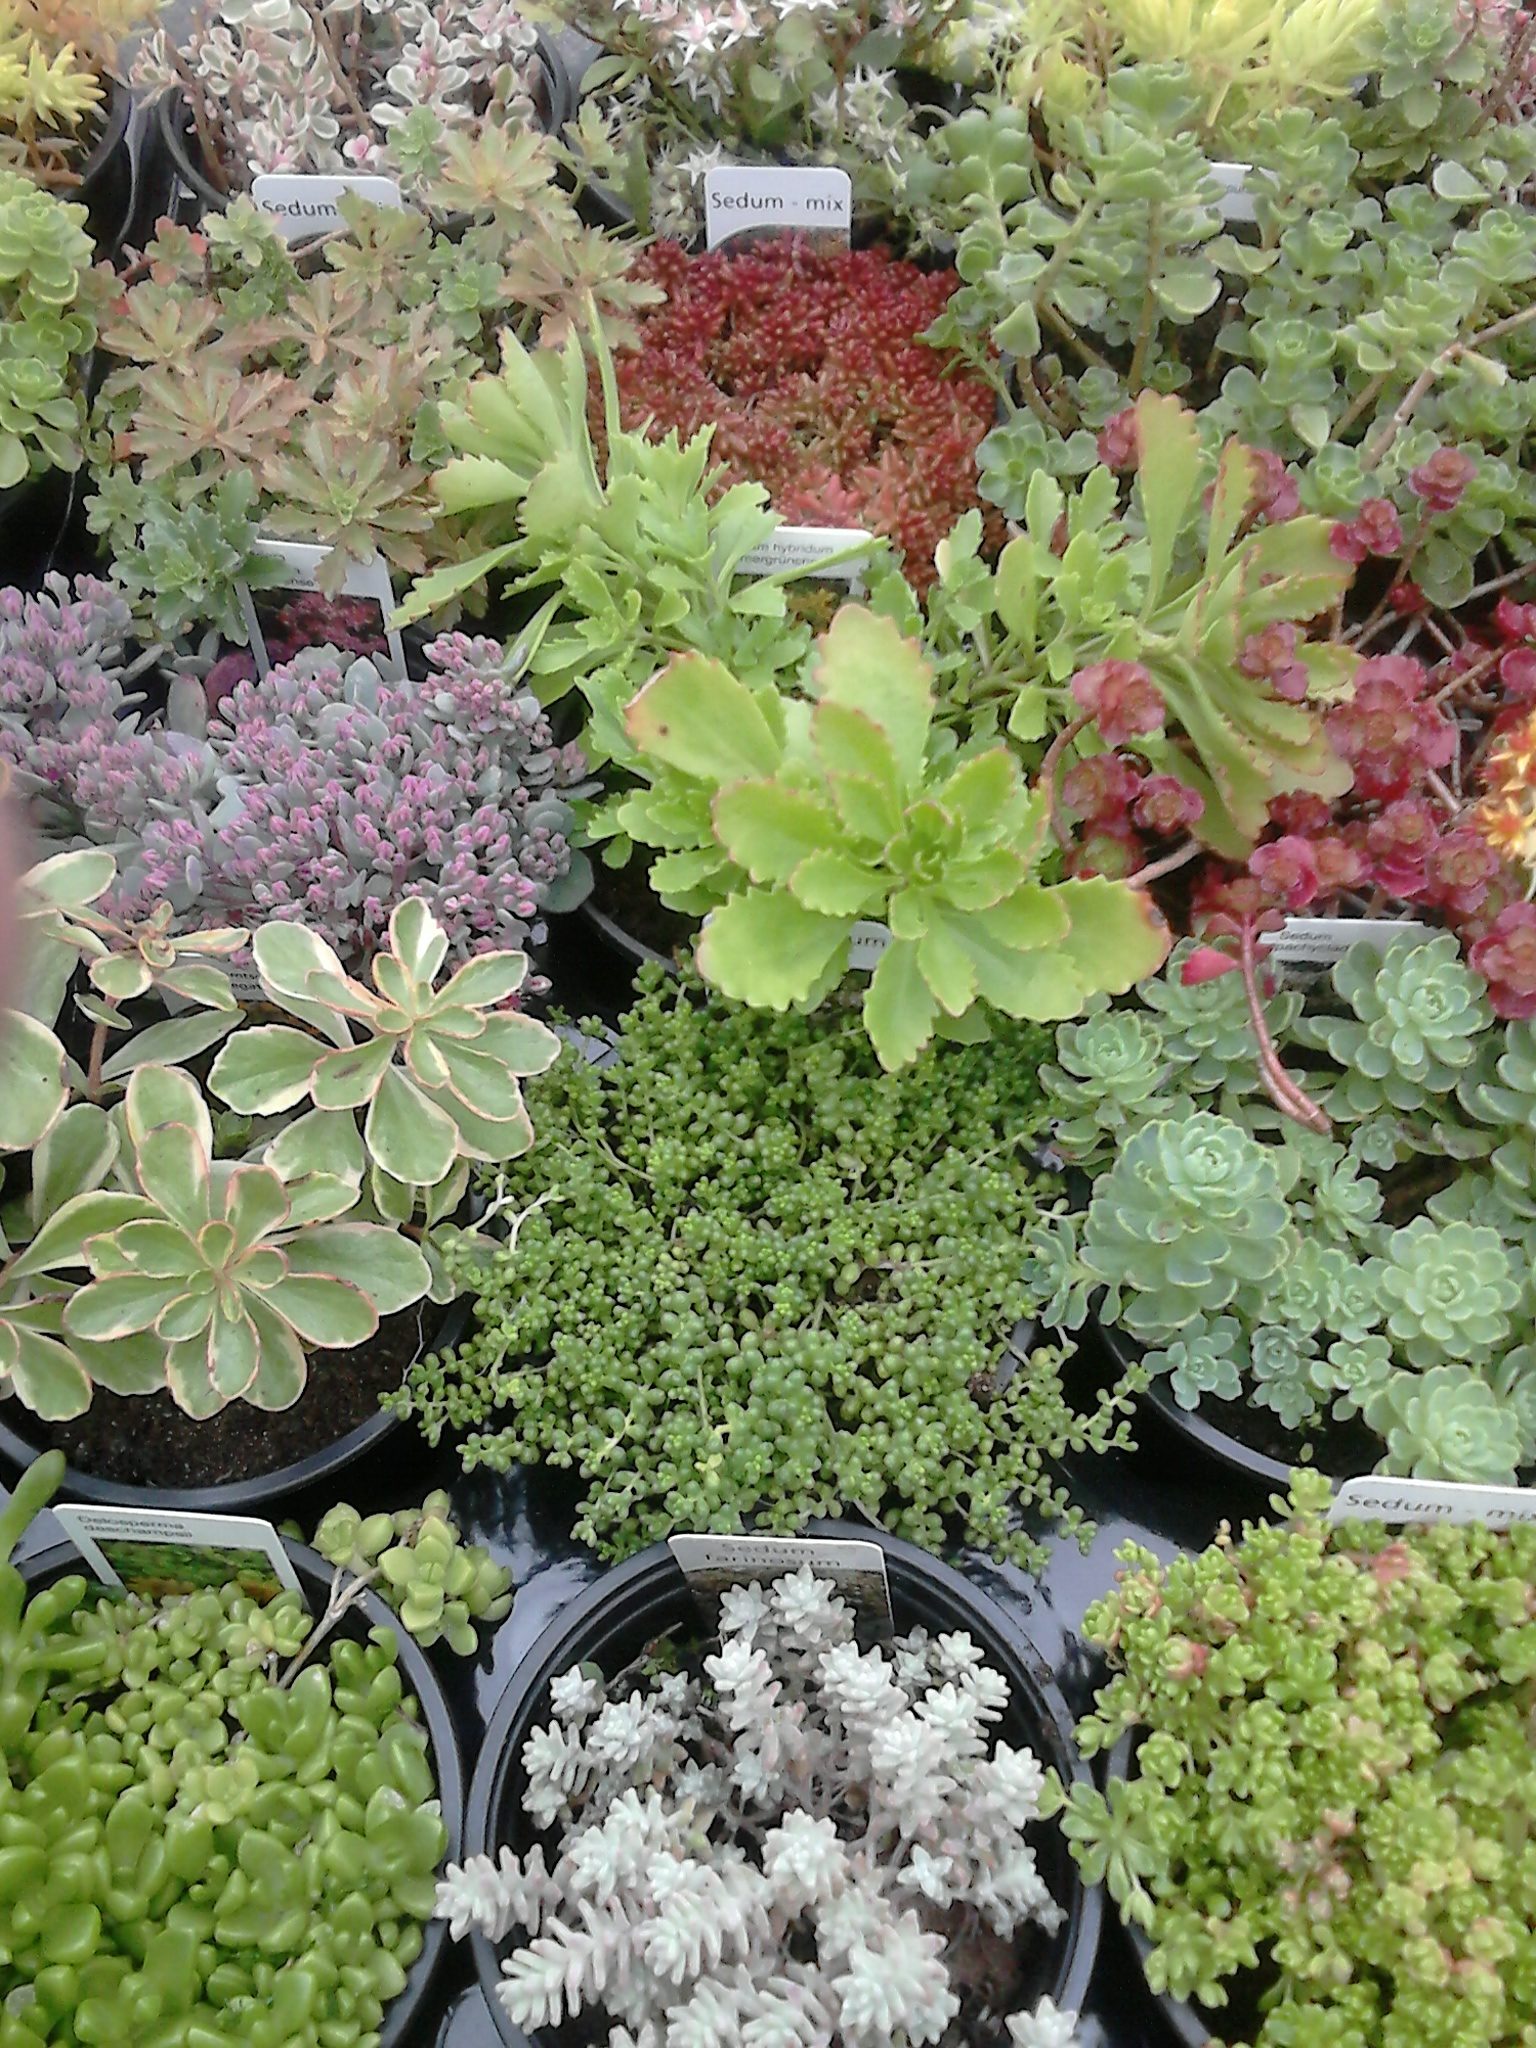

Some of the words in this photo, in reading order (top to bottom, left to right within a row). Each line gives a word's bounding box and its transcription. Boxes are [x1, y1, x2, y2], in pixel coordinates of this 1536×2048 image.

[262, 200, 338, 217] Sedum
[710, 192, 784, 209] Sedum
[805, 194, 844, 211] mix
[1346, 1494, 1453, 1514] Sedum
